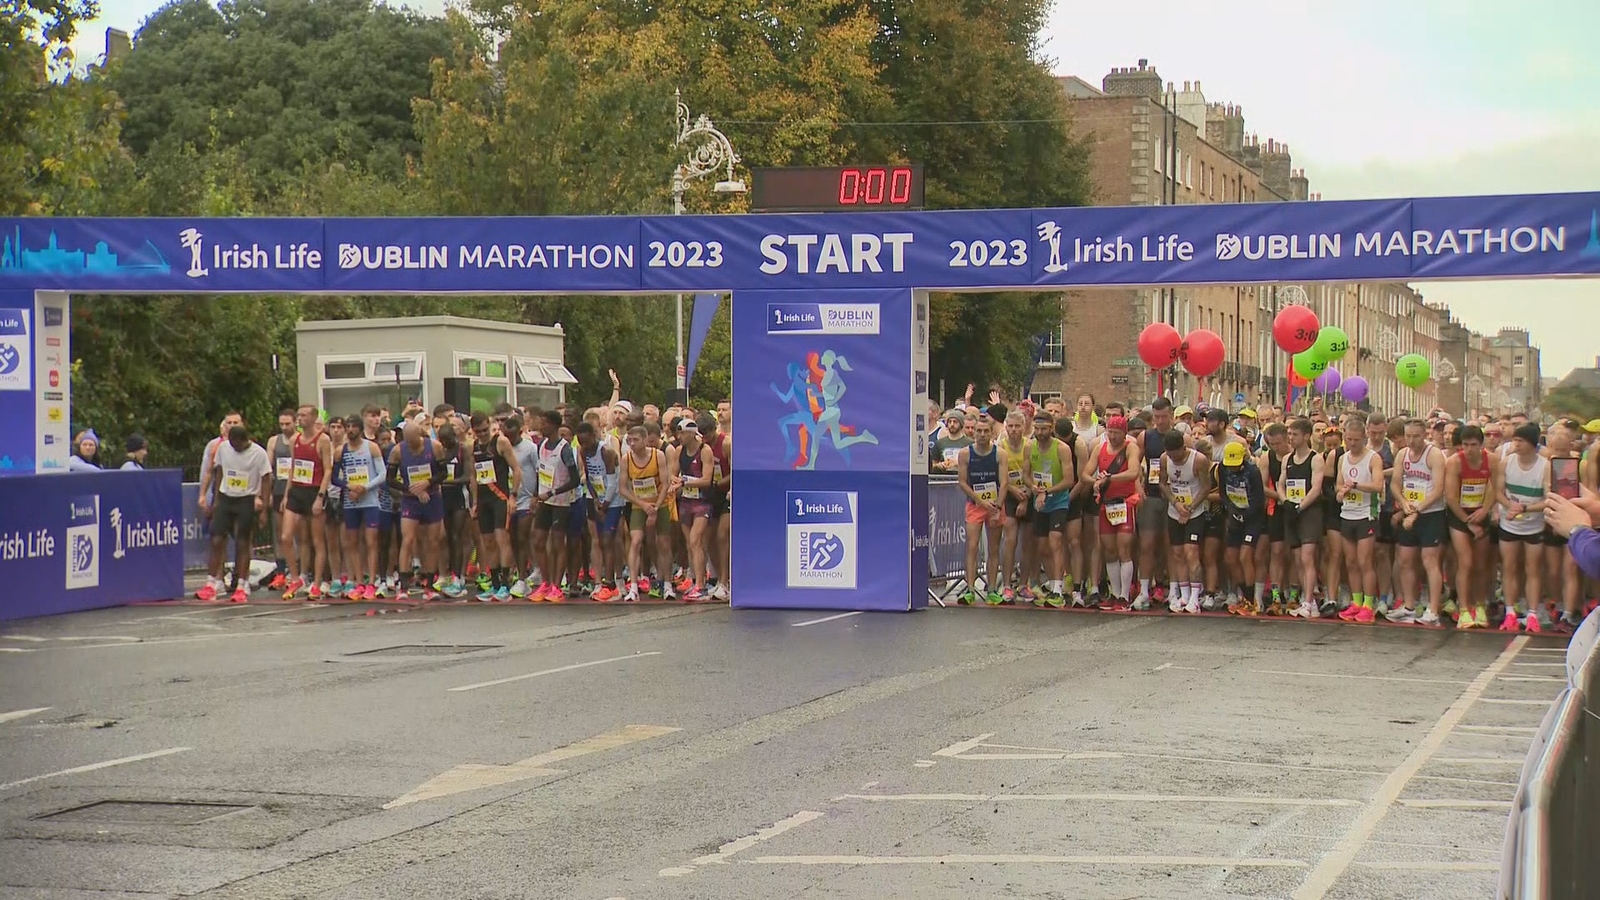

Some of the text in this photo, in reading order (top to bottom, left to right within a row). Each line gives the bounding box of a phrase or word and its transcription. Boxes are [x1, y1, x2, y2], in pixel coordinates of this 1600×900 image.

[839, 168, 912, 204] 0:00
[1073, 233, 1194, 264] Irish Life
[1215, 226, 1566, 260] DUBLIN MARATHON
[213, 243, 322, 269] Irish Life
[338, 243, 634, 269] DUBLIN MARATHON
[647, 241, 724, 268] 2023
[758, 232, 914, 275] START
[948, 239, 1028, 268] 2023
[4, 318, 19, 328] Life
[783, 313, 816, 322] Irish Life
[828, 309, 874, 320] DUBLIN
[828, 320, 874, 328] MARATHON
[231, 479, 242, 487] 29
[480, 470, 489, 478] 27
[981, 492, 992, 501] 62
[1409, 492, 1419, 500] 65
[806, 503, 844, 513] Irish Life
[1108, 511, 1125, 521] 1097
[27, 529, 55, 557] Life
[127, 519, 179, 549] Irish Life
[799, 531, 808, 570] DUBLIN
[799, 571, 844, 579] MARATHON
